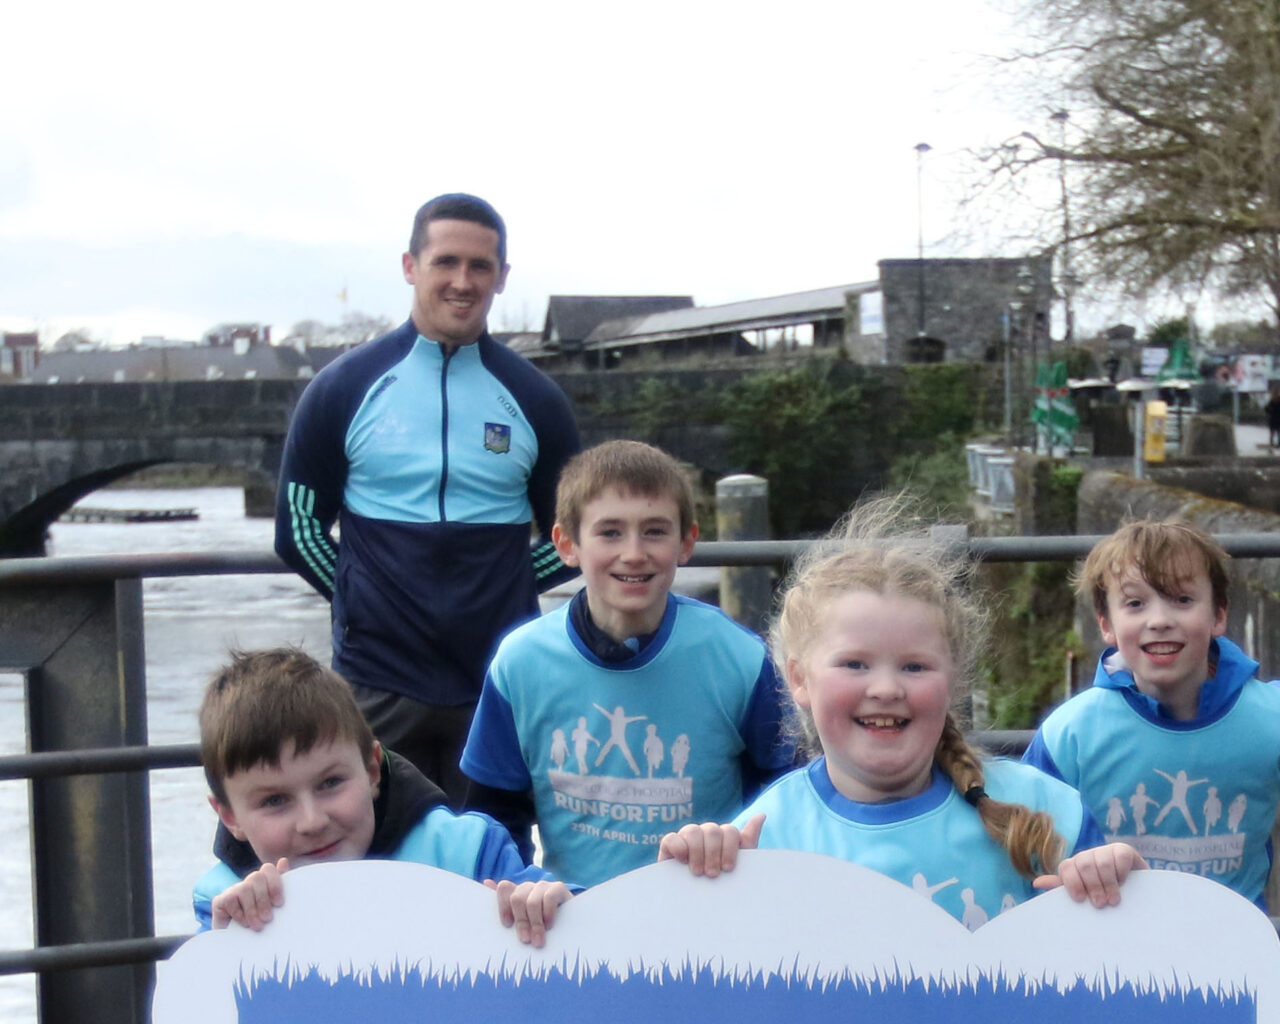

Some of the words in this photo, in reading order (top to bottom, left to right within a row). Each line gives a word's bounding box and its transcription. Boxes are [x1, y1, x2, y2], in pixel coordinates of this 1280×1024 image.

[554, 791, 598, 815] RUN
[599, 803, 643, 822] FOR
[647, 802, 693, 822] FUN
[571, 822, 600, 837] 29TH
[603, 829, 639, 844] APRIL
[1201, 857, 1243, 875] FUN
